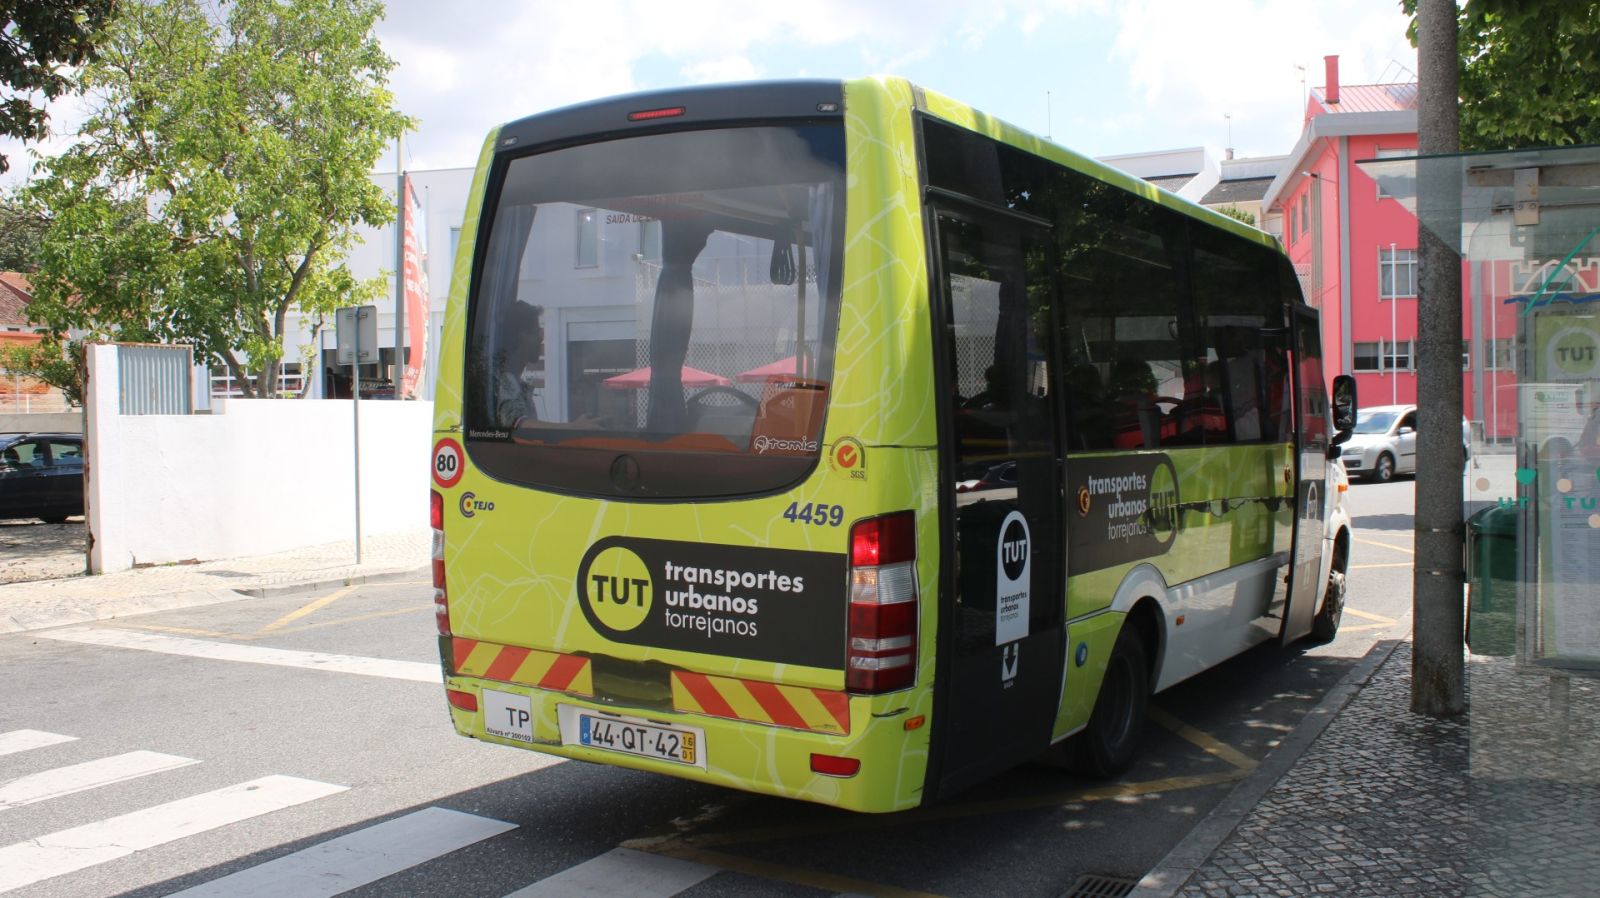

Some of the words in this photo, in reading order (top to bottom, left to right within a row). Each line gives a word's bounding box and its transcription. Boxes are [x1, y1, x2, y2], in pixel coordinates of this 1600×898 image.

[1557, 346, 1597, 361] TUT
[469, 430, 509, 438] Mercedes-Benz
[437, 454, 456, 472] 80
[850, 470, 865, 479] SGS
[1088, 471, 1147, 499] transportes
[783, 501, 844, 527] 4459
[1108, 494, 1147, 518] urbanos
[1108, 518, 1147, 543] torrejanos
[1003, 539, 1027, 564] TUT
[665, 560, 804, 593] transportes
[592, 574, 649, 608] TUT
[665, 584, 758, 615] urbanos
[1000, 591, 1027, 604] transportes
[1000, 603, 1019, 614] urbanos
[665, 608, 758, 638] torrejanos
[505, 707, 530, 729] TP
[682, 750, 693, 761] 01
